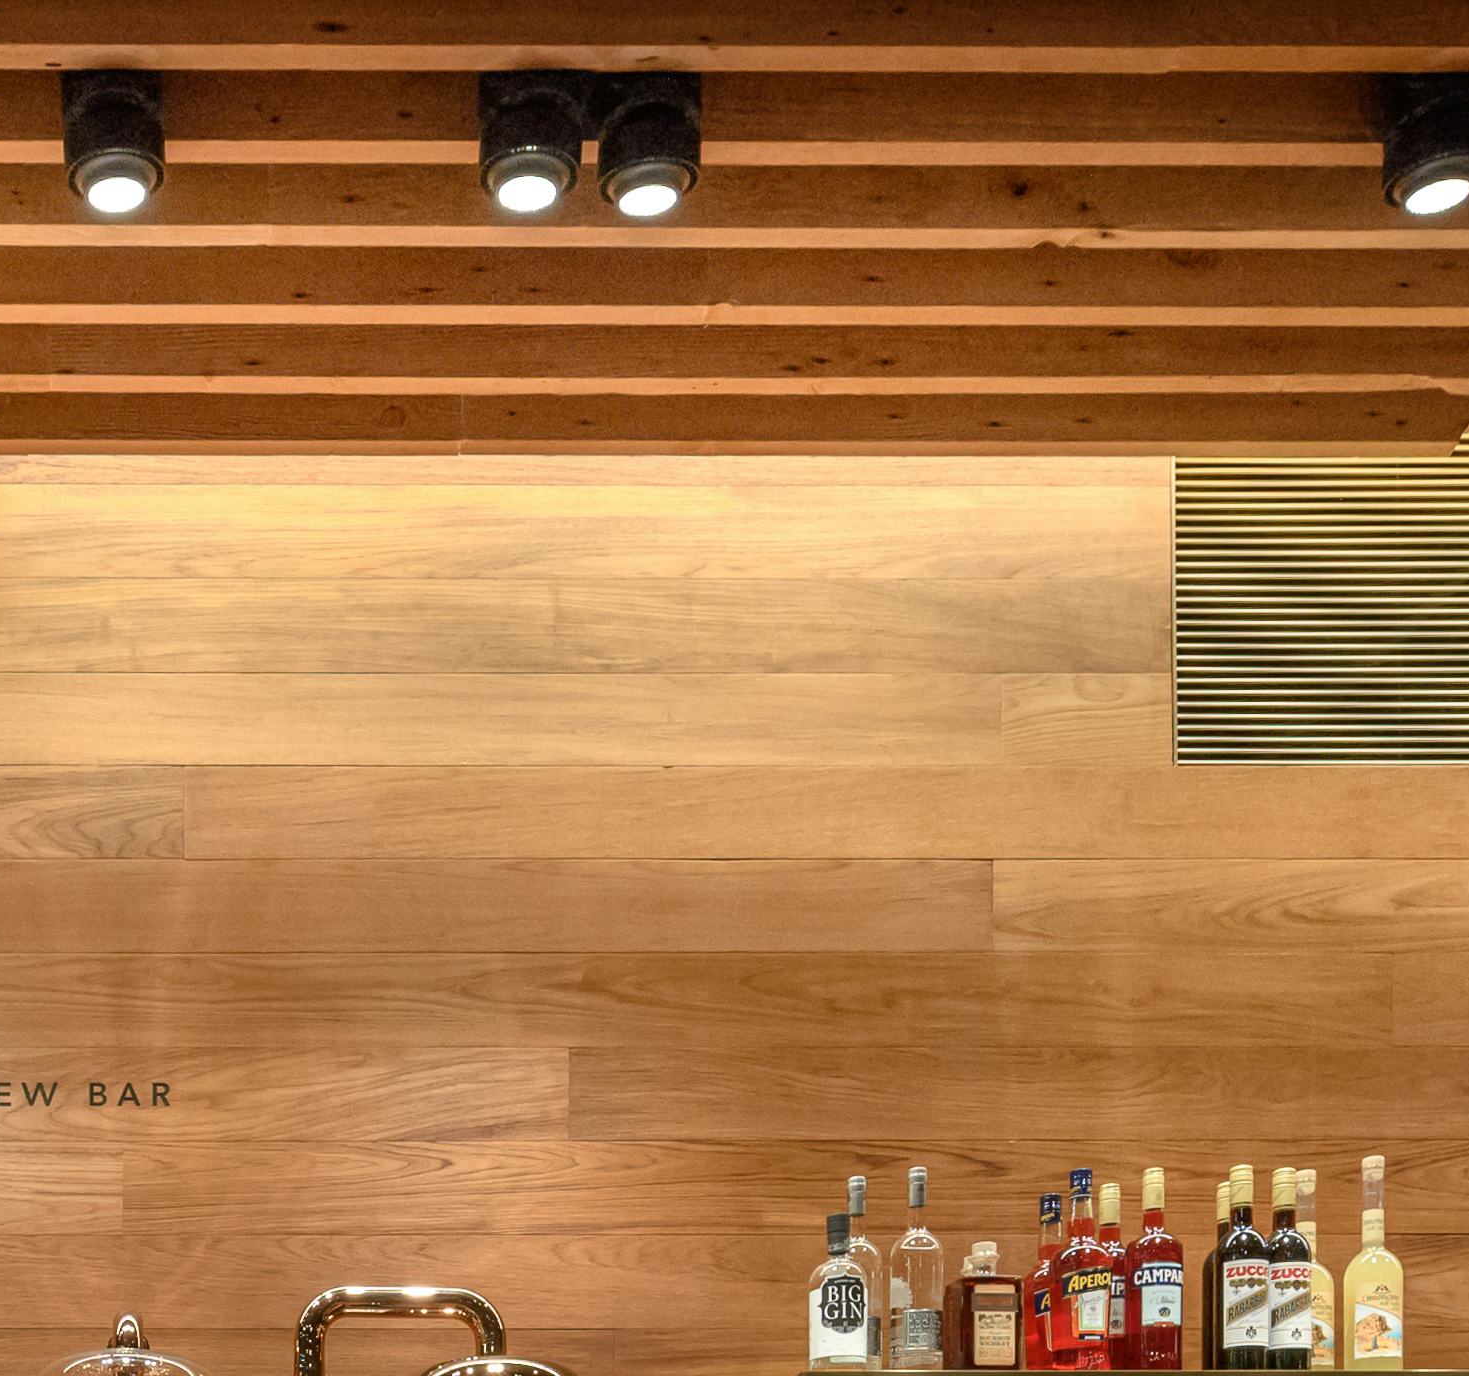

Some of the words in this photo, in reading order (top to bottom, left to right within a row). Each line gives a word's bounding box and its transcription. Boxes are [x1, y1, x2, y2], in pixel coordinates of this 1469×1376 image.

[88, 1081, 172, 1108] BAR
[827, 1285, 862, 1303] BIG
[824, 1302, 863, 1320] GIN
